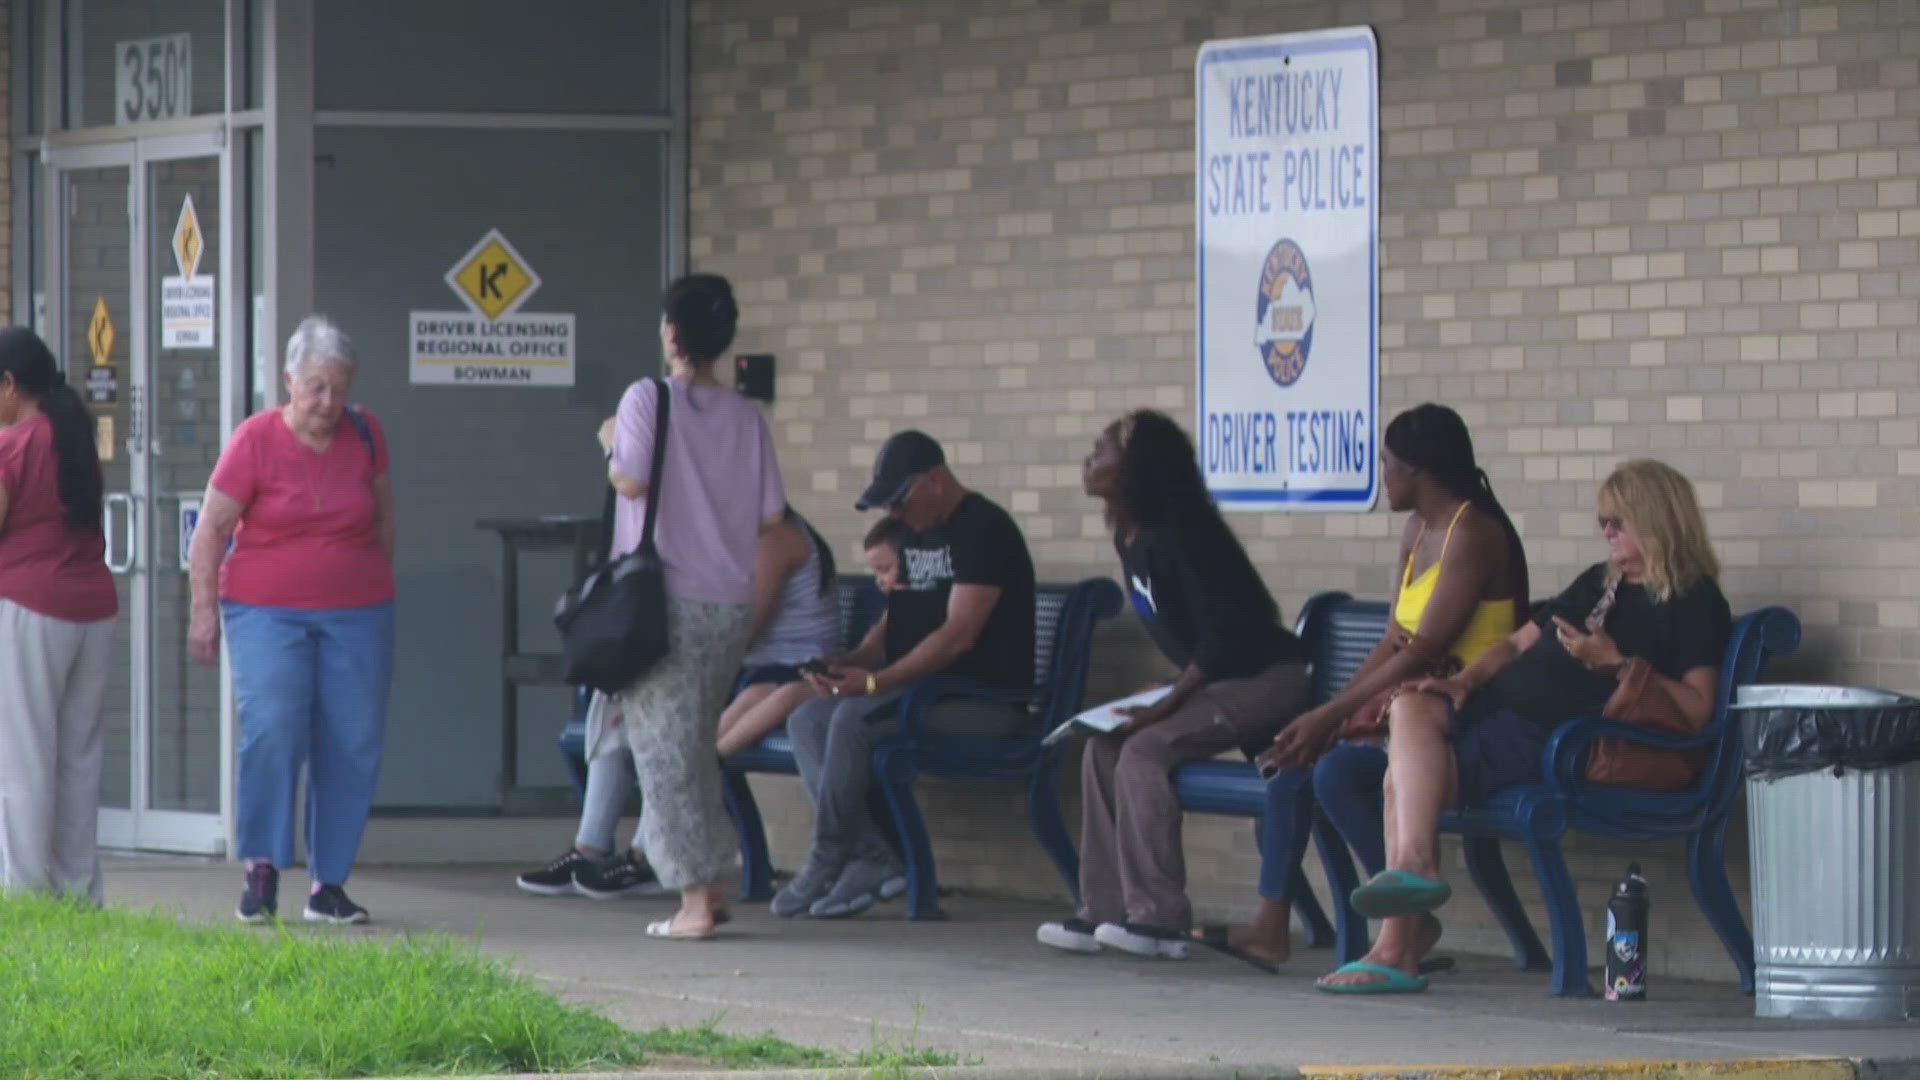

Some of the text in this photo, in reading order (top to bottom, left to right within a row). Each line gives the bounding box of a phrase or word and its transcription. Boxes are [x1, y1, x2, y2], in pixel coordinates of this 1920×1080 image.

[124, 38, 188, 122] 3501
[1230, 67, 1343, 138] KENTUCKY
[1209, 144, 1366, 216] STATE POLICE
[416, 321, 569, 338] DRIVER LICENSING
[416, 340, 568, 357] REGIONAL OFFICE
[453, 366, 532, 381] BOWMAN
[1208, 409, 1365, 474] DRIVER TESTING
